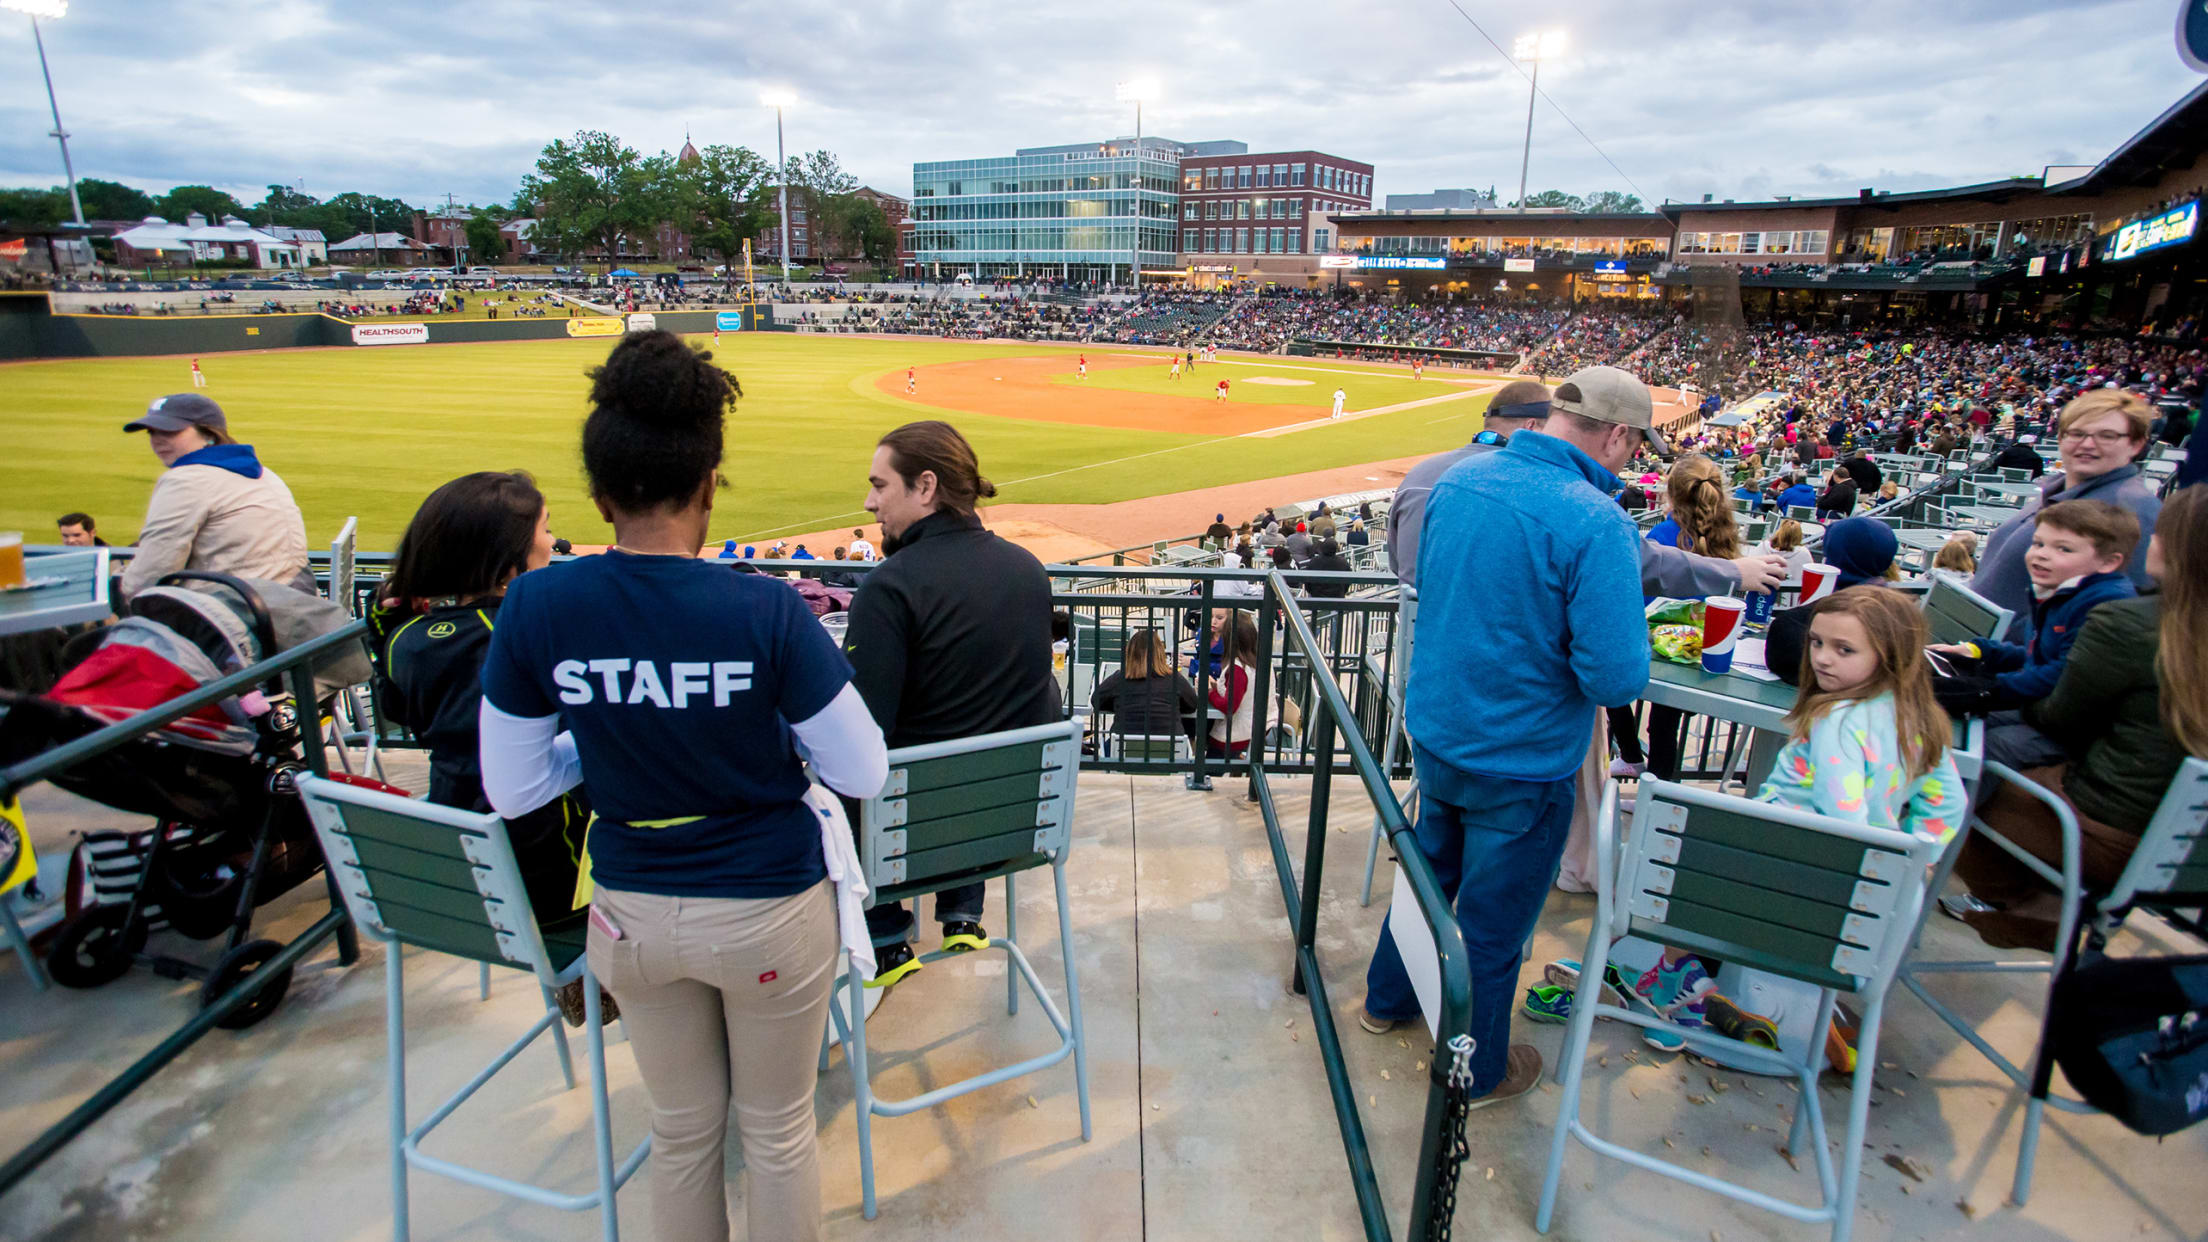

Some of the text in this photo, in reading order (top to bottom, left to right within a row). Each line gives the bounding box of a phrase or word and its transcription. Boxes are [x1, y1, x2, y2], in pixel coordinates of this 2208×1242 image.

[359, 328, 423, 336] HEALTHSOUTH
[1755, 591, 1767, 617] pep
[552, 658, 754, 709] STAFF
